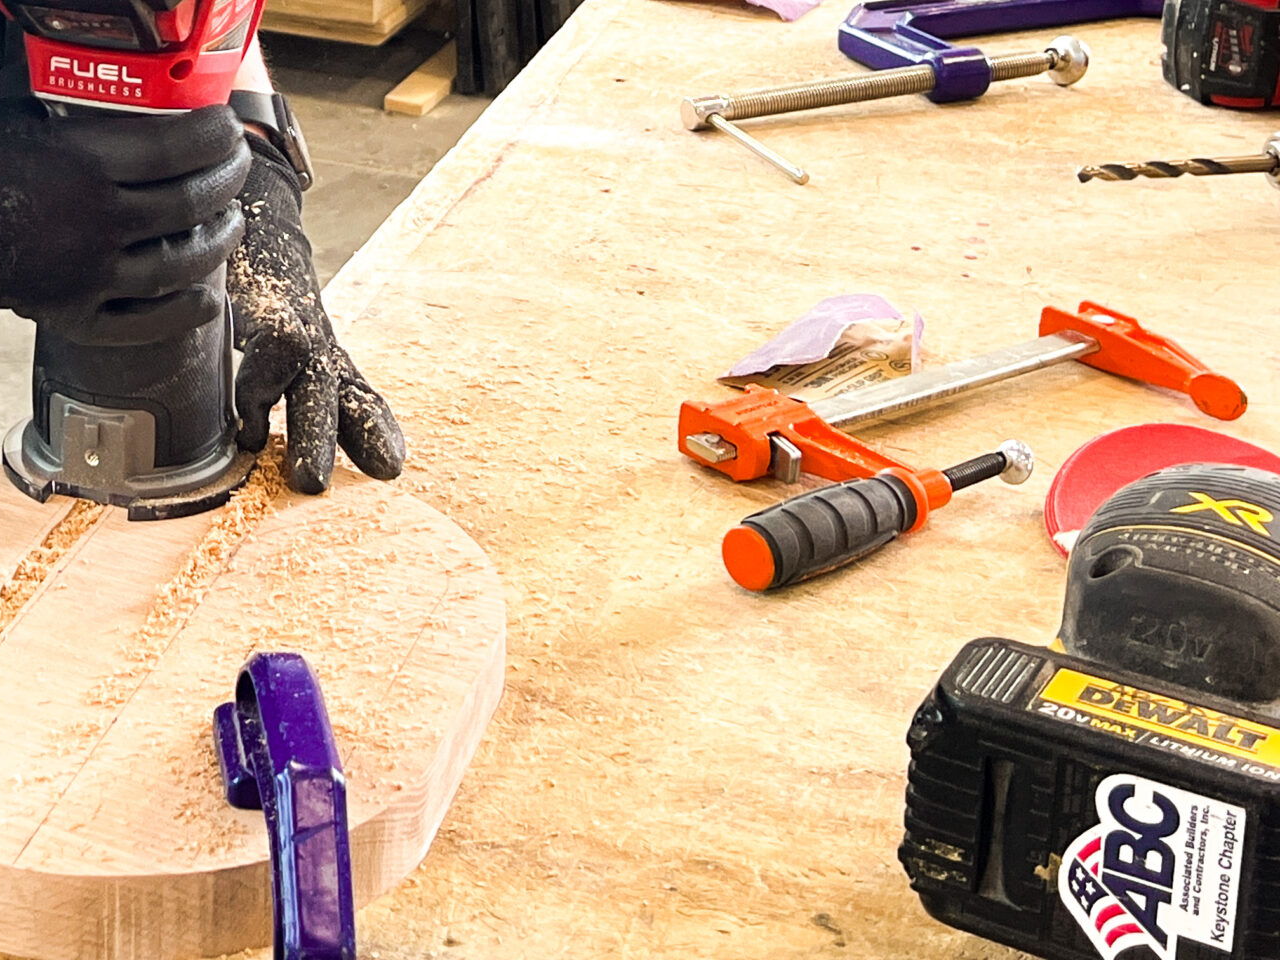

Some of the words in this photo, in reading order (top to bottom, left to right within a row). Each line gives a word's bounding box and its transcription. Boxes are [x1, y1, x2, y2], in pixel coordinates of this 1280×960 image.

[48, 75, 143, 98] BRUSHLESS
[50, 55, 143, 84] FUEL
[1168, 491, 1275, 537] XR
[1077, 684, 1269, 751] DEWALT
[1089, 718, 1138, 739] MAX
[1149, 736, 1237, 767] LITHIUM
[1240, 763, 1280, 781] ION
[1185, 805, 1199, 849] Builders
[1200, 805, 1210, 825] Inc.
[1218, 809, 1238, 870] Chapter
[1101, 783, 1181, 952] ABC
[1179, 853, 1193, 913] Associated
[1193, 829, 1210, 894] Contractors,
[1192, 897, 1200, 917] and
[1210, 875, 1231, 943] Keystone
